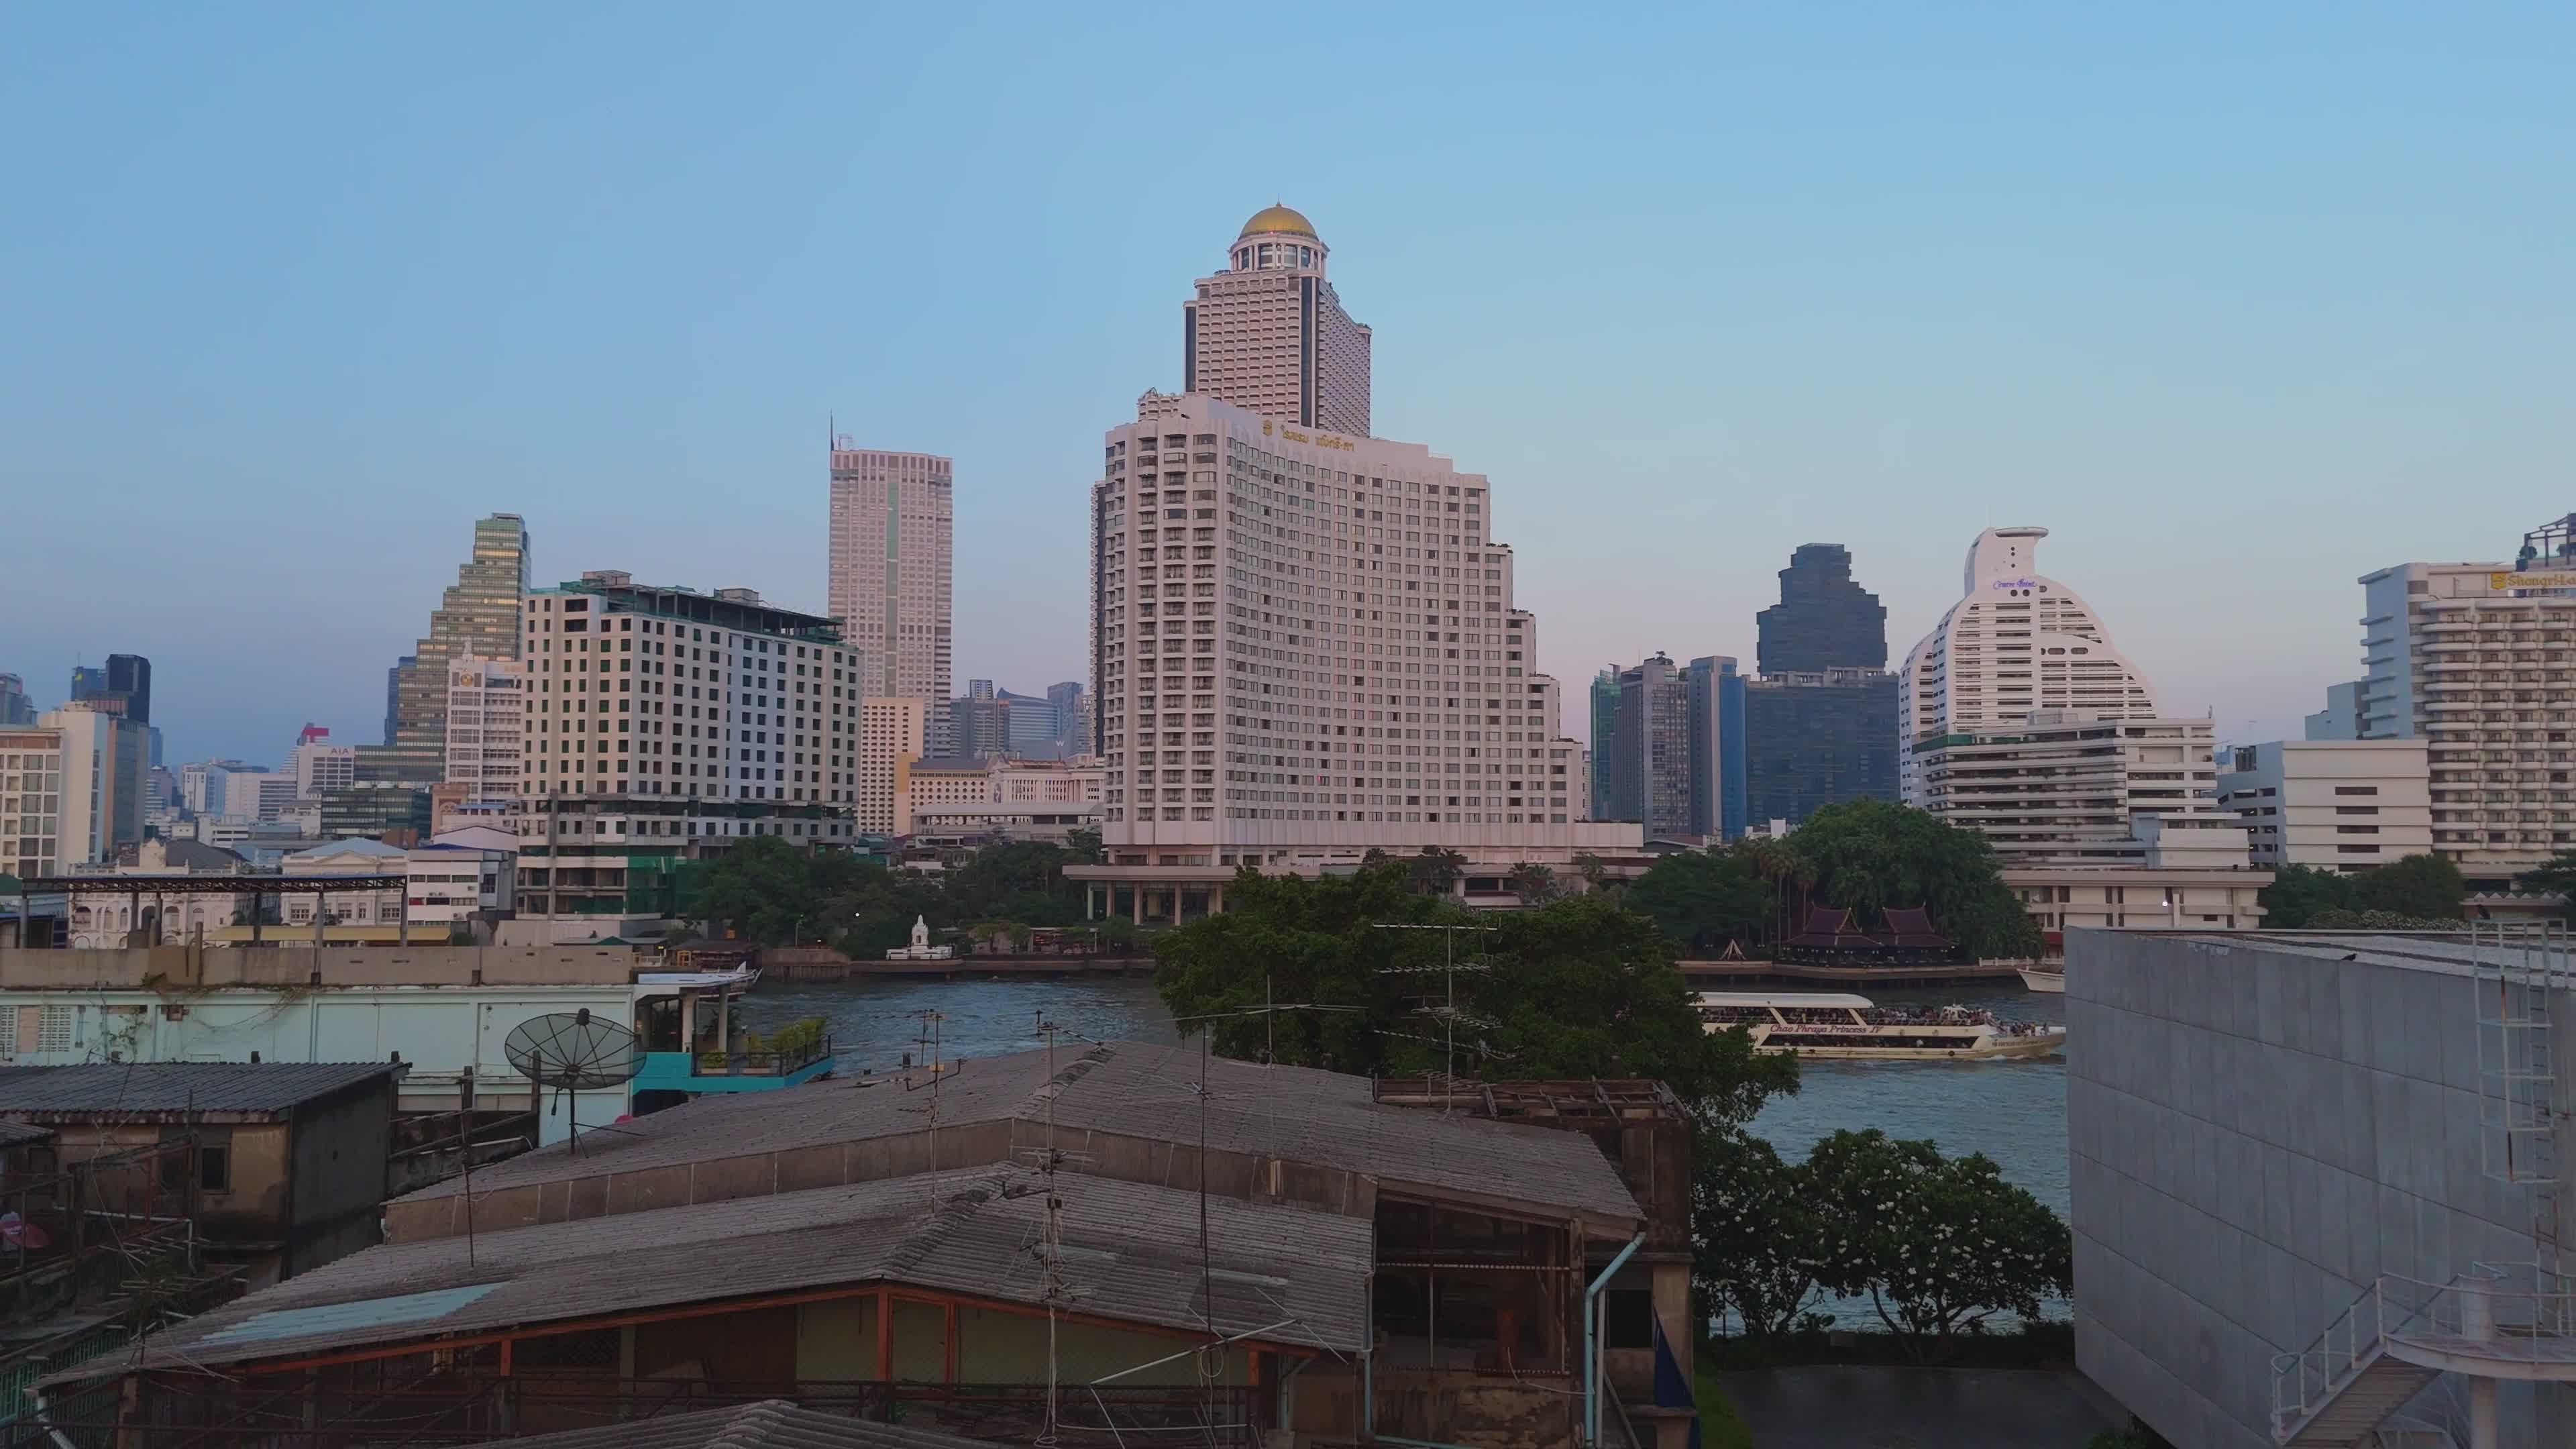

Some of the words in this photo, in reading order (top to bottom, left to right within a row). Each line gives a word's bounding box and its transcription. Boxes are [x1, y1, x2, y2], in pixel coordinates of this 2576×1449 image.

[1770, 1024, 1793, 1032] Chao
[1795, 1024, 1827, 1034] Phraya
[1829, 1025, 1866, 1033] Princess
